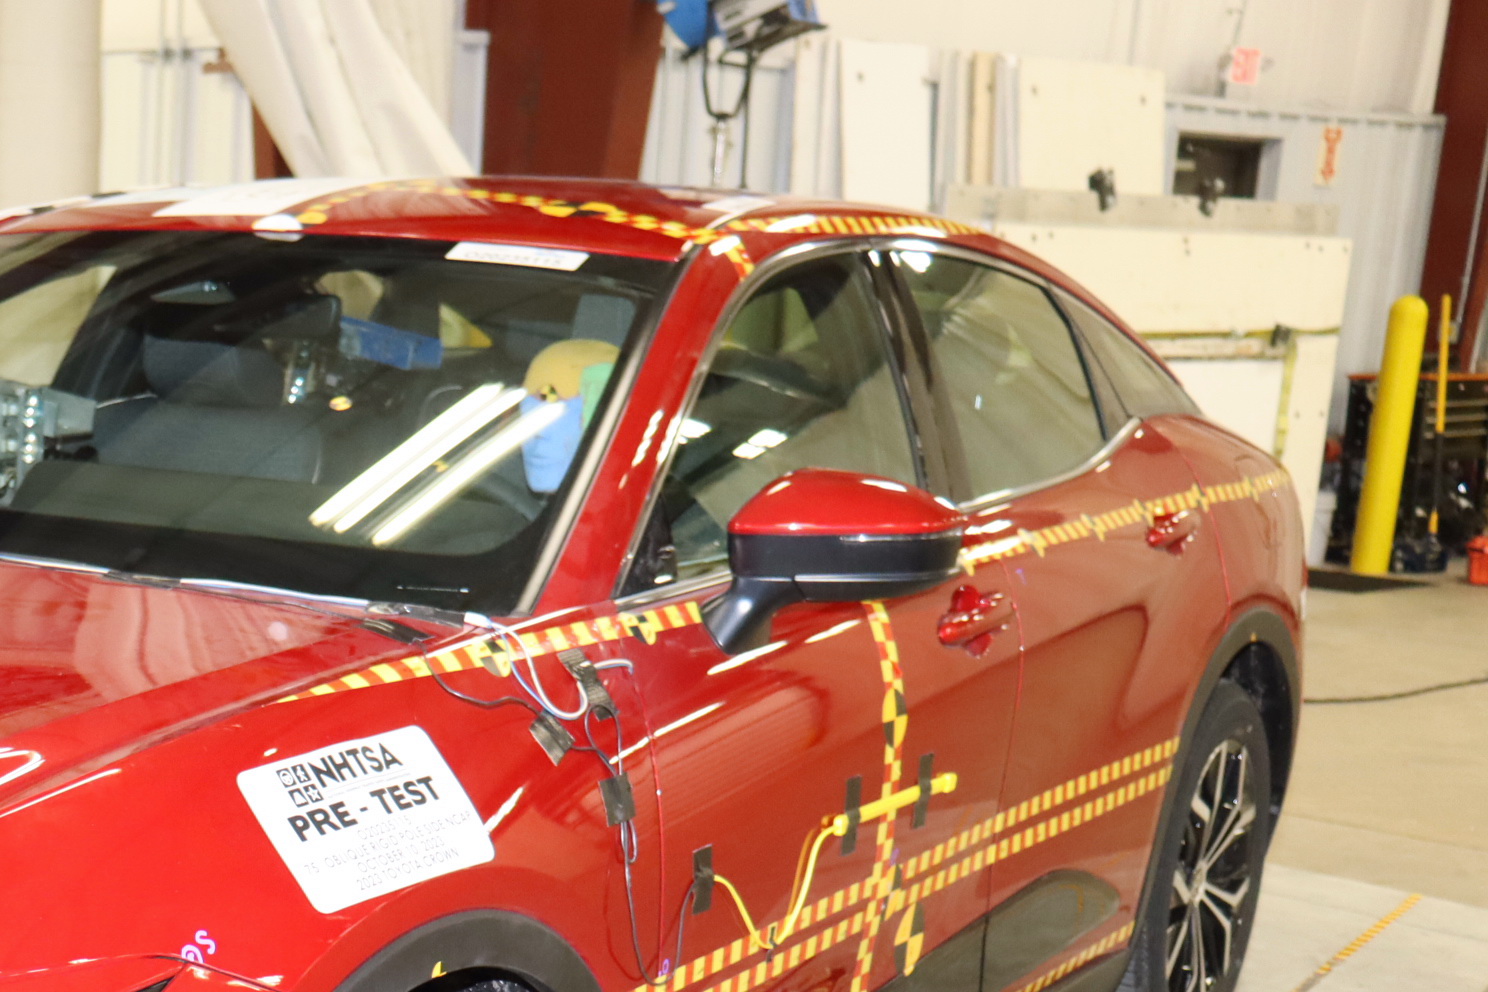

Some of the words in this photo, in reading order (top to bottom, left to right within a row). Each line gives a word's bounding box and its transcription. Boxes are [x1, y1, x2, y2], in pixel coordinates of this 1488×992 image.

[308, 743, 404, 788] NHTSA
[287, 800, 358, 842] PRE
[369, 776, 440, 815] TEST
[324, 843, 371, 869] OBLIQUE
[370, 834, 399, 852] RIGID
[399, 825, 424, 841] POLE
[423, 818, 447, 834] SIDE
[445, 810, 472, 827] NCAP
[357, 848, 405, 874] OCTOBER
[421, 836, 446, 853] 2023
[356, 873, 383, 891] 2023
[381, 859, 423, 881] TOYOTA
[422, 846, 460, 868] CROWN
